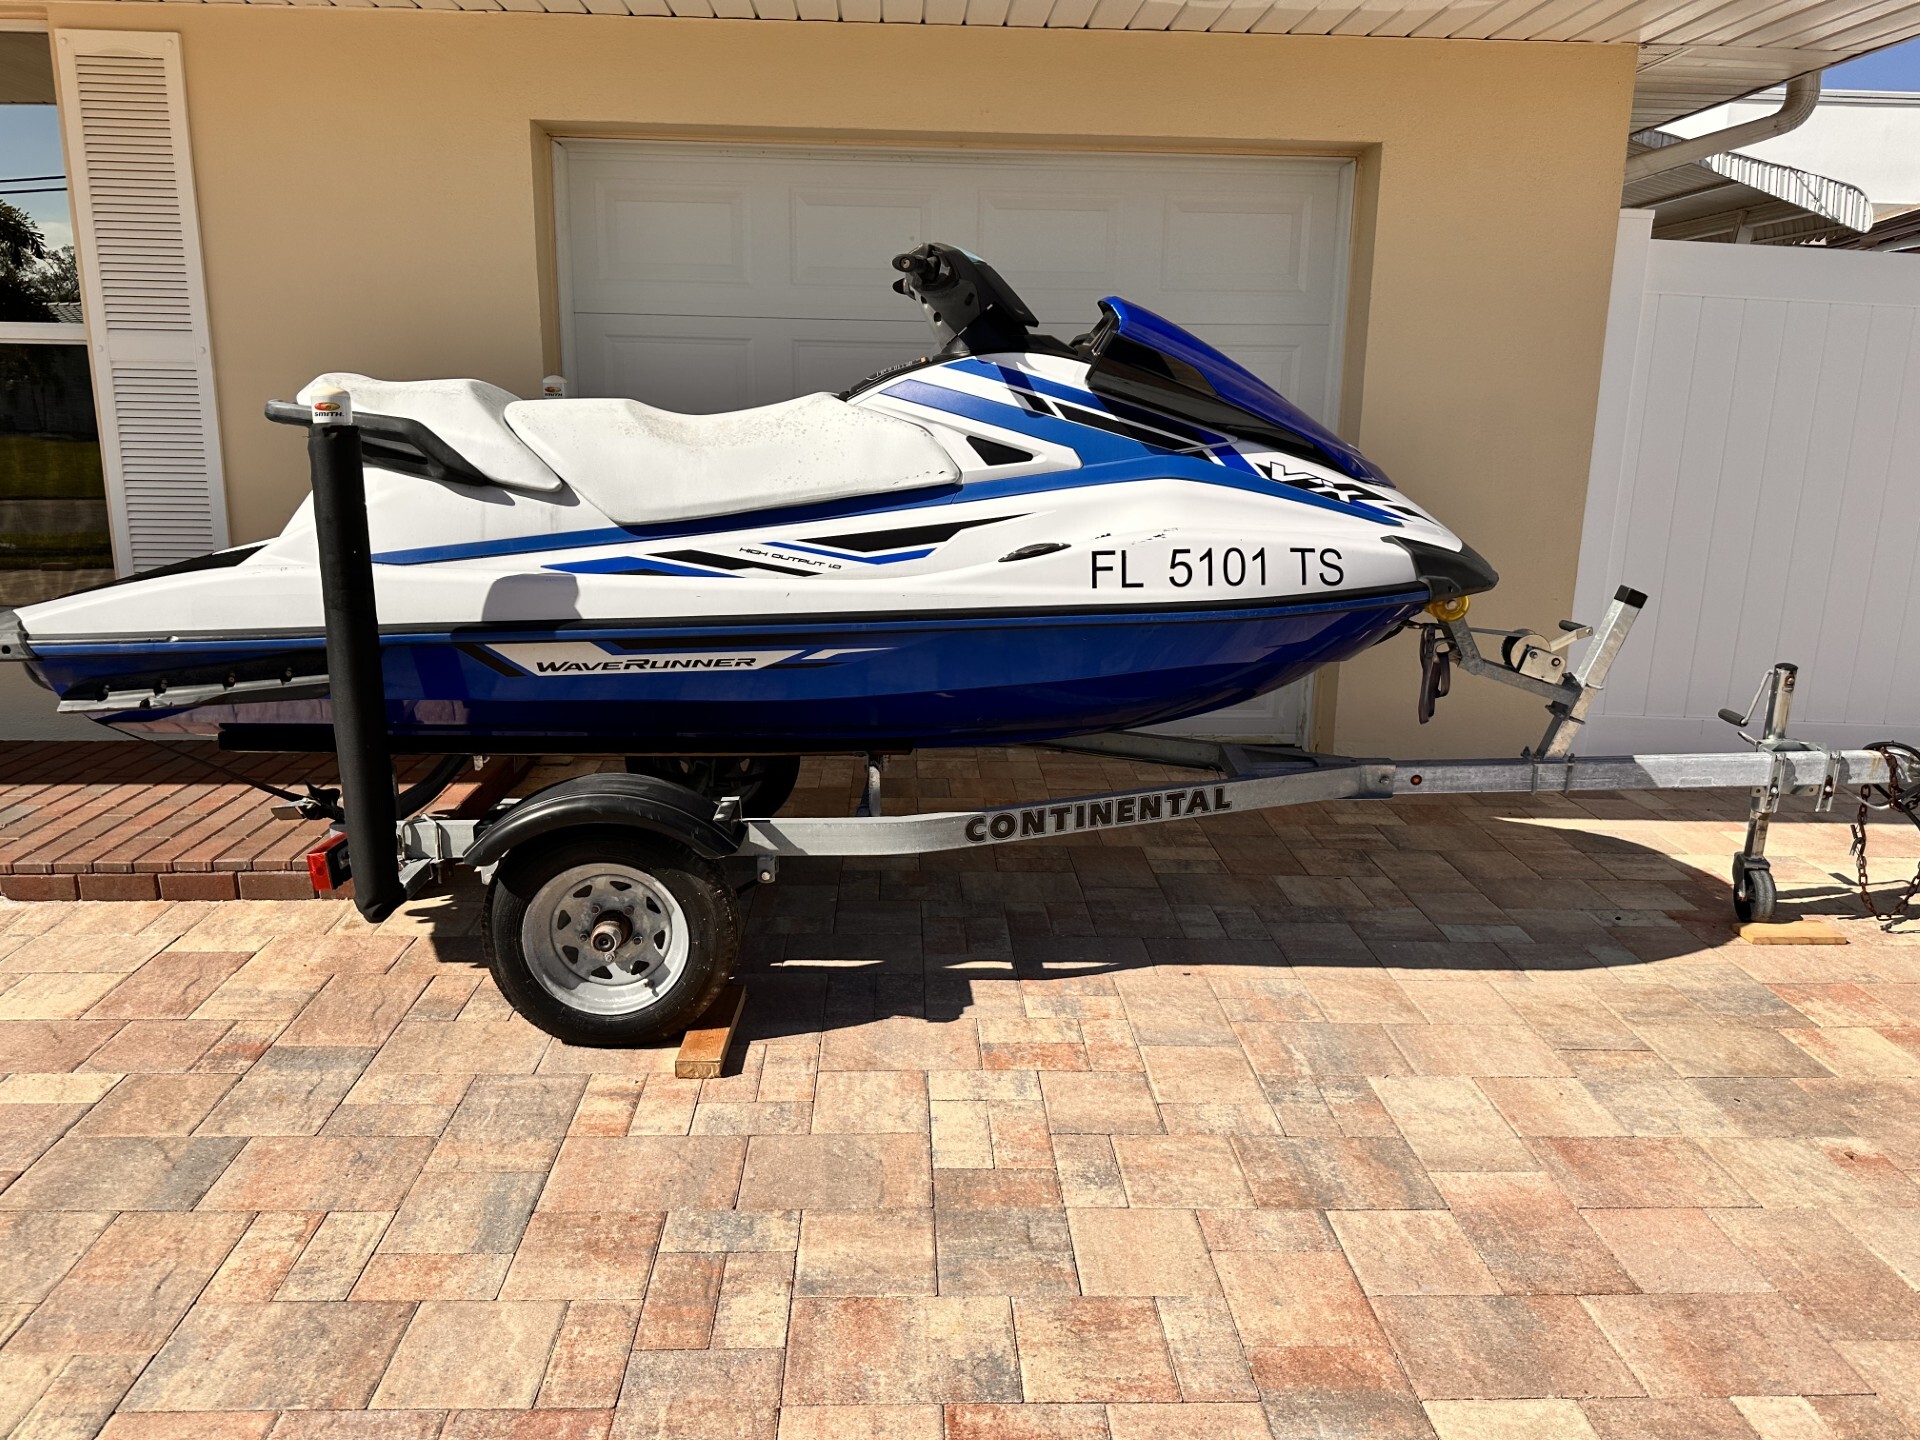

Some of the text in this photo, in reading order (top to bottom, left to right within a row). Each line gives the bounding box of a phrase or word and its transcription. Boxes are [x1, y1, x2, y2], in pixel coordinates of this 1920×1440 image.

[1269, 461, 1363, 503] VX
[739, 547, 768, 557] HIGH
[771, 553, 826, 566] OUTPUT
[1091, 547, 1344, 589] FL 5101 TS
[965, 785, 1232, 843] CONTINENTAL
